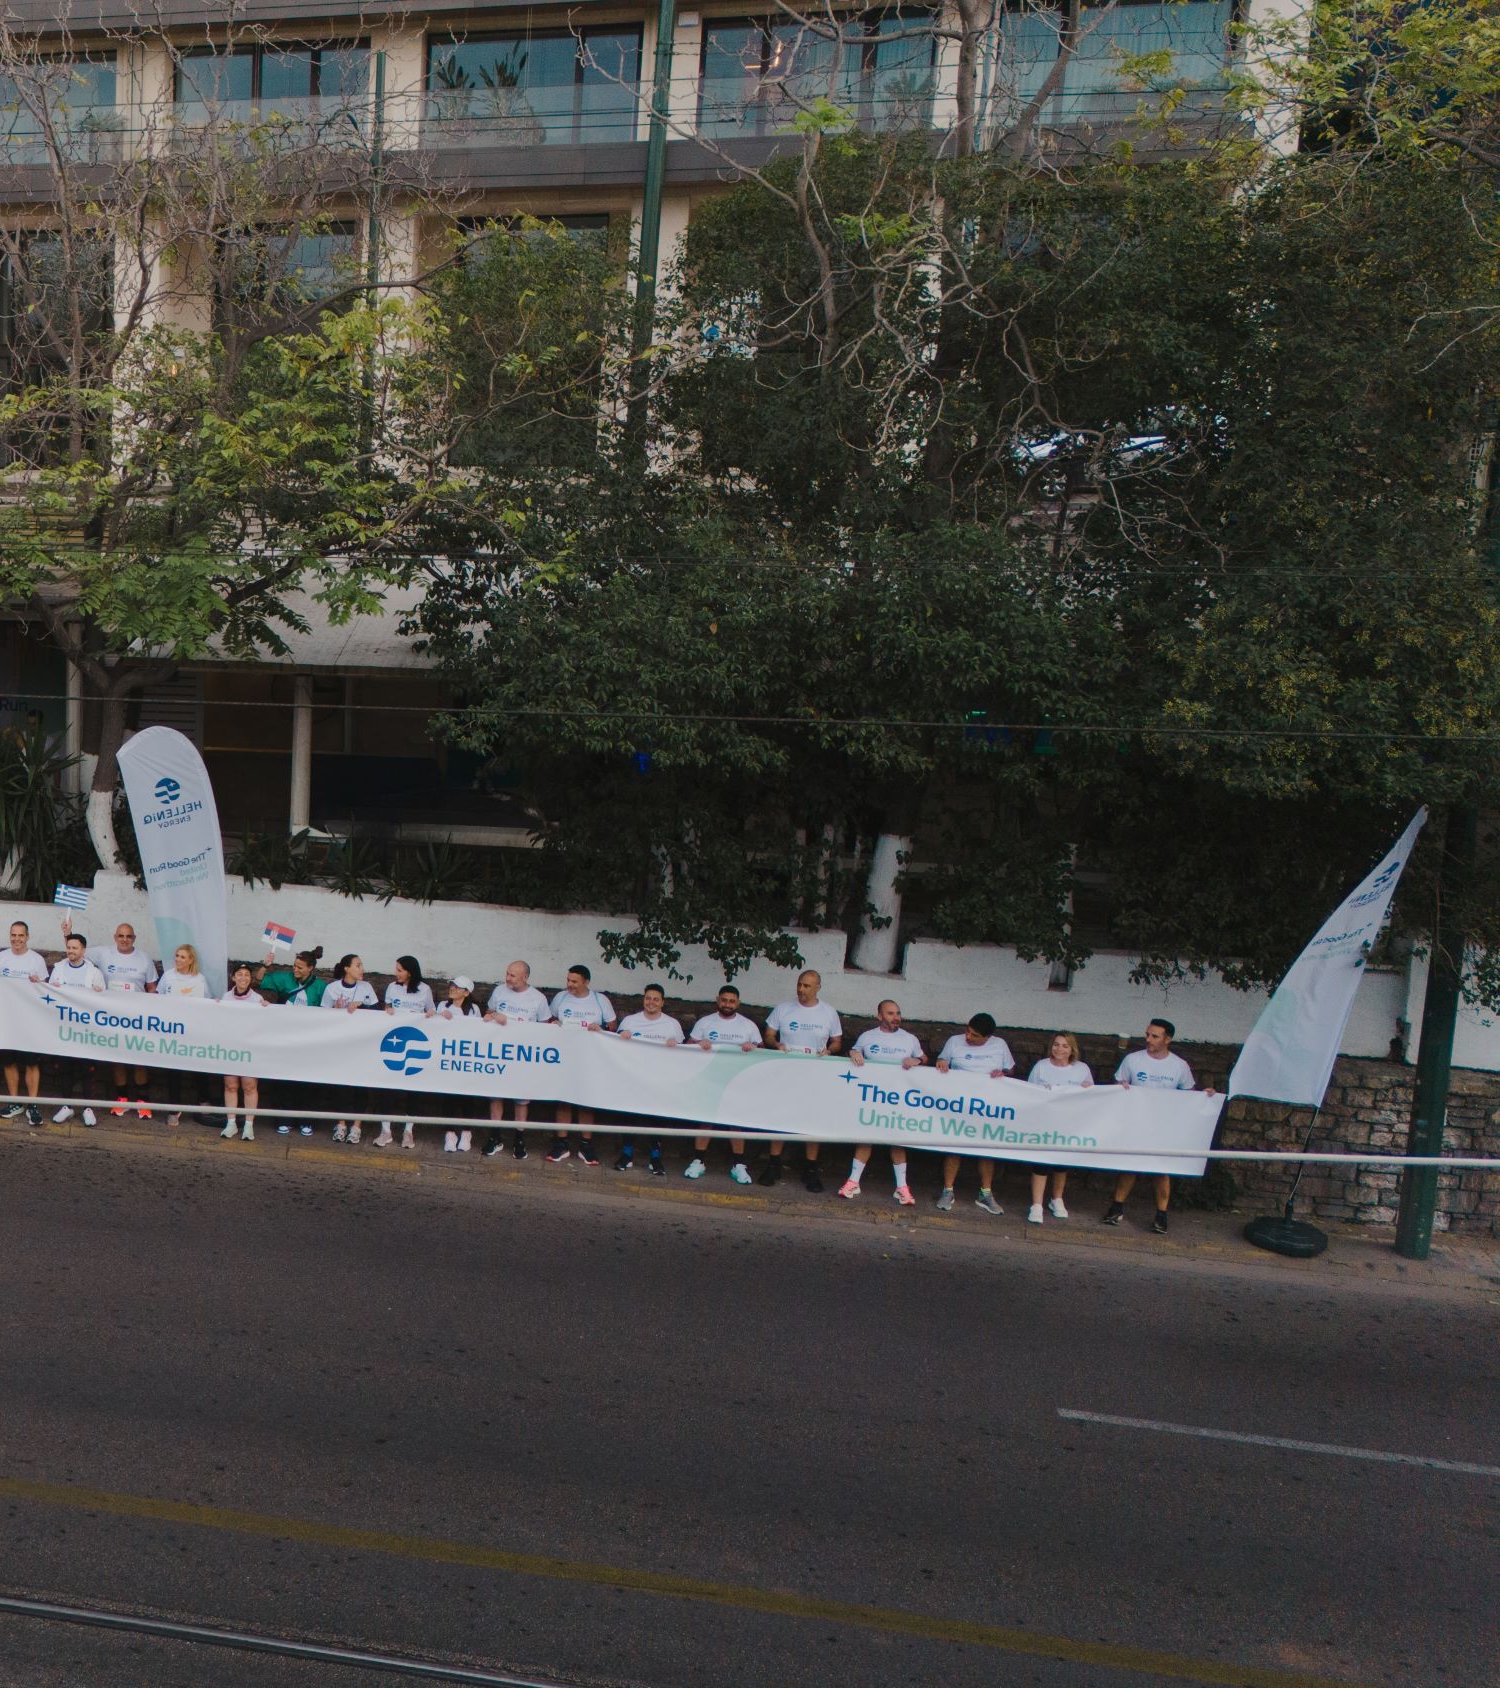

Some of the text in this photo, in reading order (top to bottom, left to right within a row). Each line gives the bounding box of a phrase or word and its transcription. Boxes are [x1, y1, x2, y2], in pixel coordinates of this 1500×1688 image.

[55, 1005, 185, 1034] The Good Run
[58, 1026, 252, 1063] United We Marathon
[441, 1038, 561, 1064] HELLENiQ
[440, 1059, 507, 1075] ENERGY
[857, 1083, 1016, 1121] The Good Run
[857, 1107, 1097, 1147] United We Marathon
